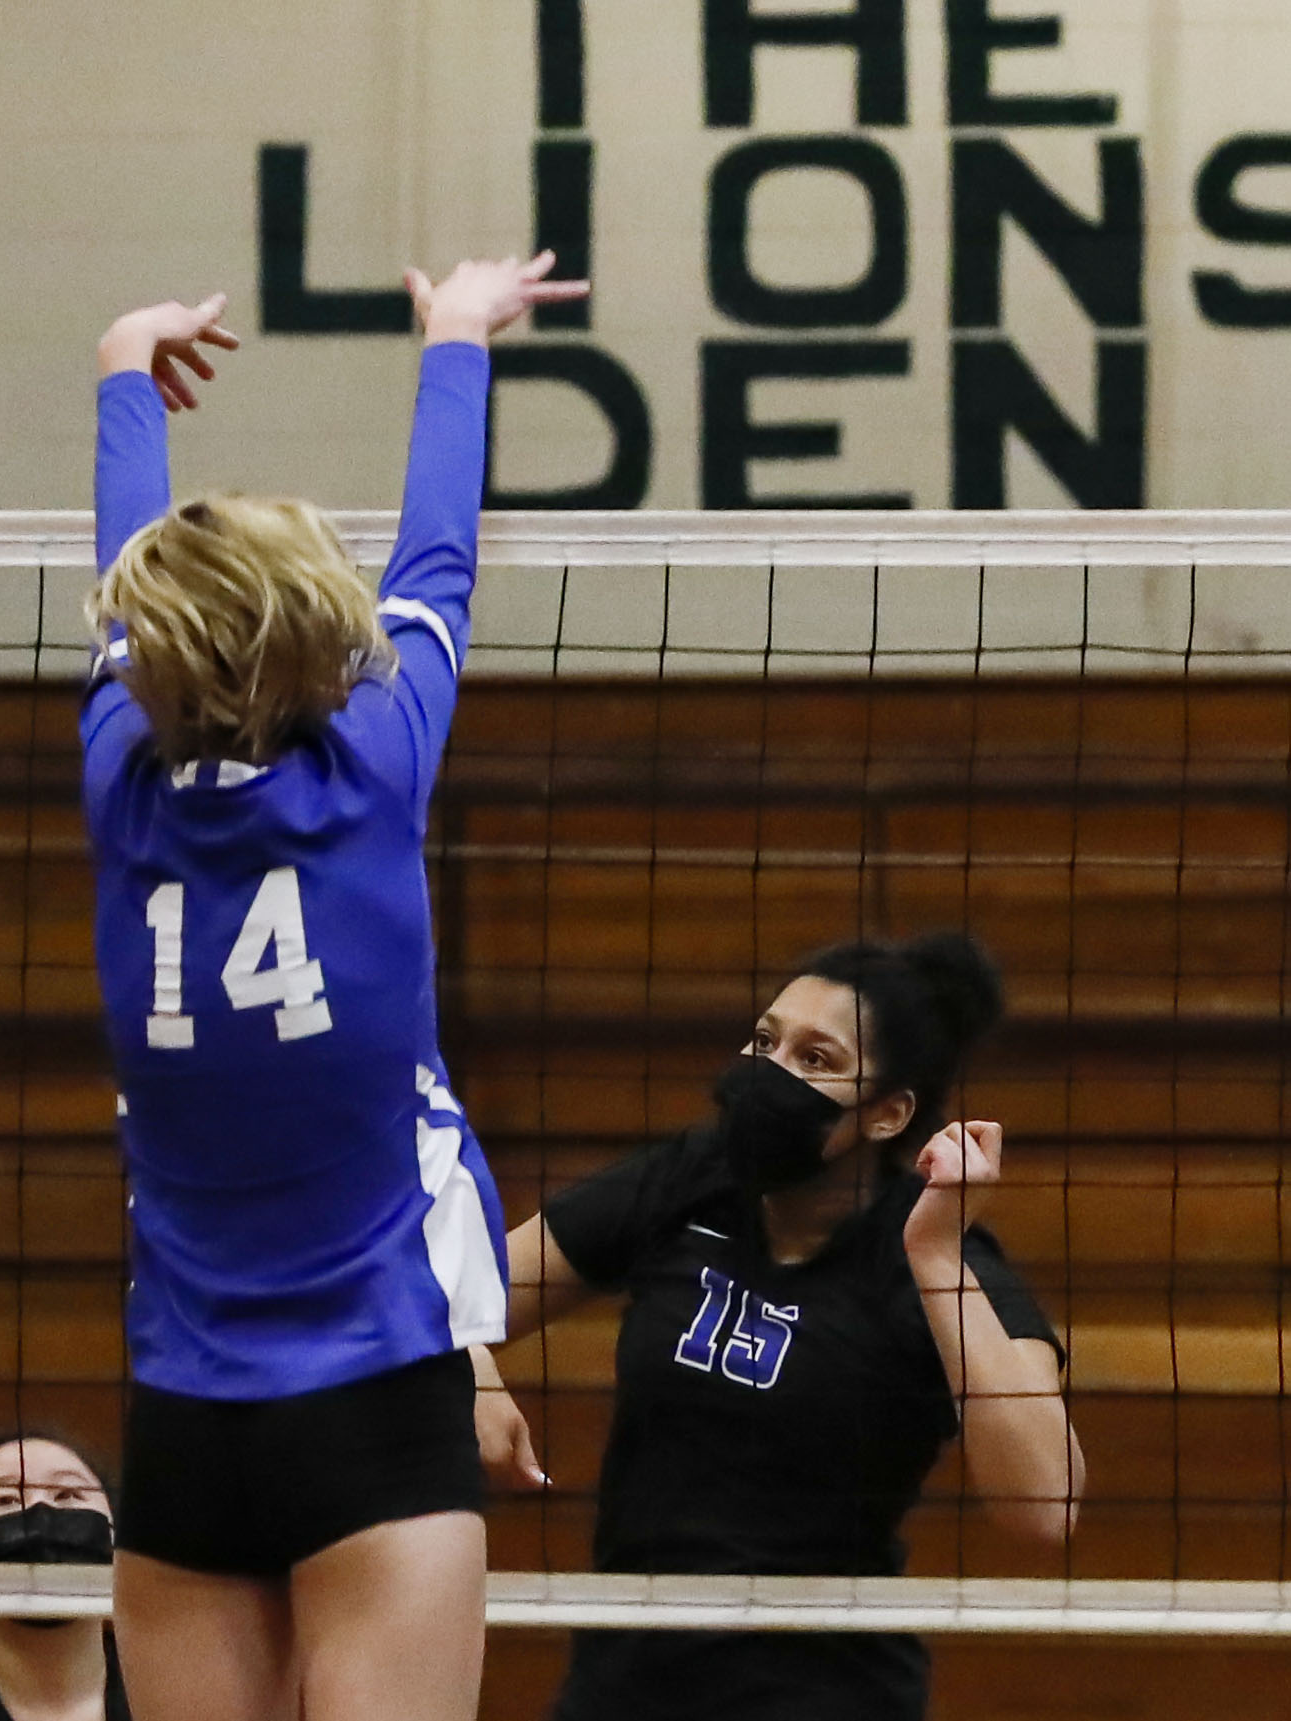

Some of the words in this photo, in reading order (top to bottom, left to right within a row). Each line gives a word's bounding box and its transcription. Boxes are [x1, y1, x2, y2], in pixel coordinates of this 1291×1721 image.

[481, 339, 1147, 510] DEN
[146, 865, 333, 1049] 14
[674, 1266, 799, 1389] 15
